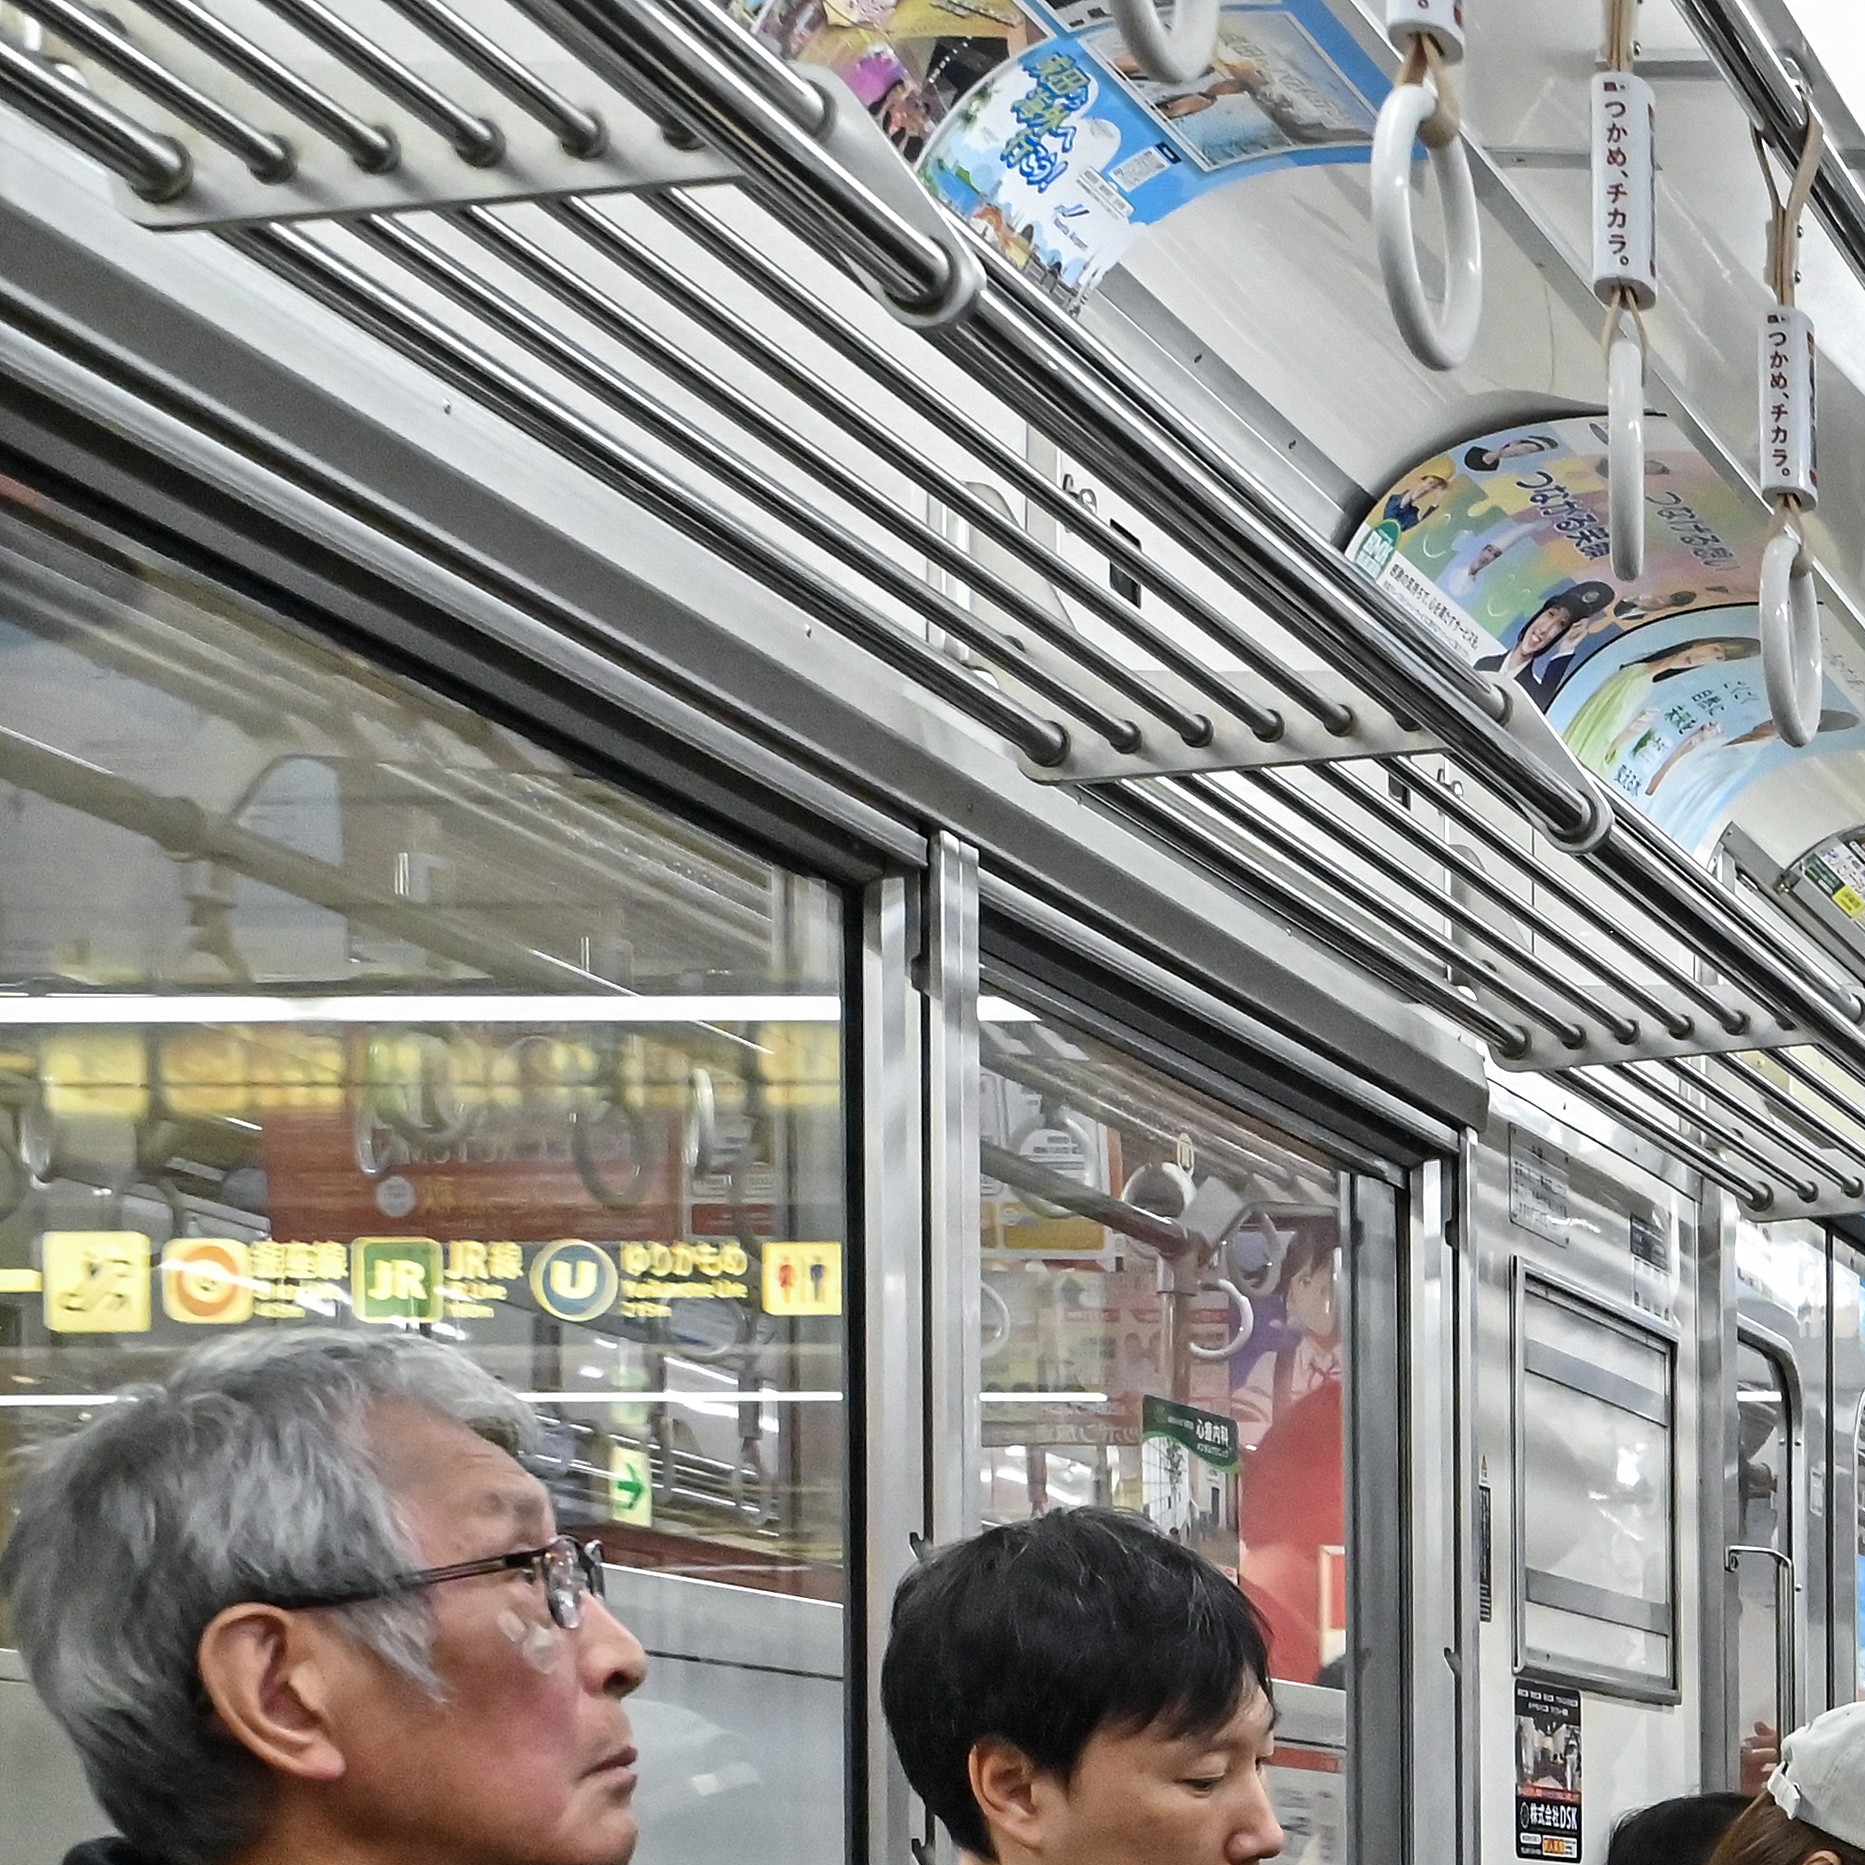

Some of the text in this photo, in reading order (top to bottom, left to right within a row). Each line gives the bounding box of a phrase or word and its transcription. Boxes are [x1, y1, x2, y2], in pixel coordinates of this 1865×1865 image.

[1603, 100, 1630, 268] つかめ、チカラ。
[1767, 331, 1793, 478] つかめ、チカラ。
[368, 1259, 427, 1300] JR
[549, 1259, 598, 1296] U
[1530, 1802, 1577, 1830] 株式会社DSK
